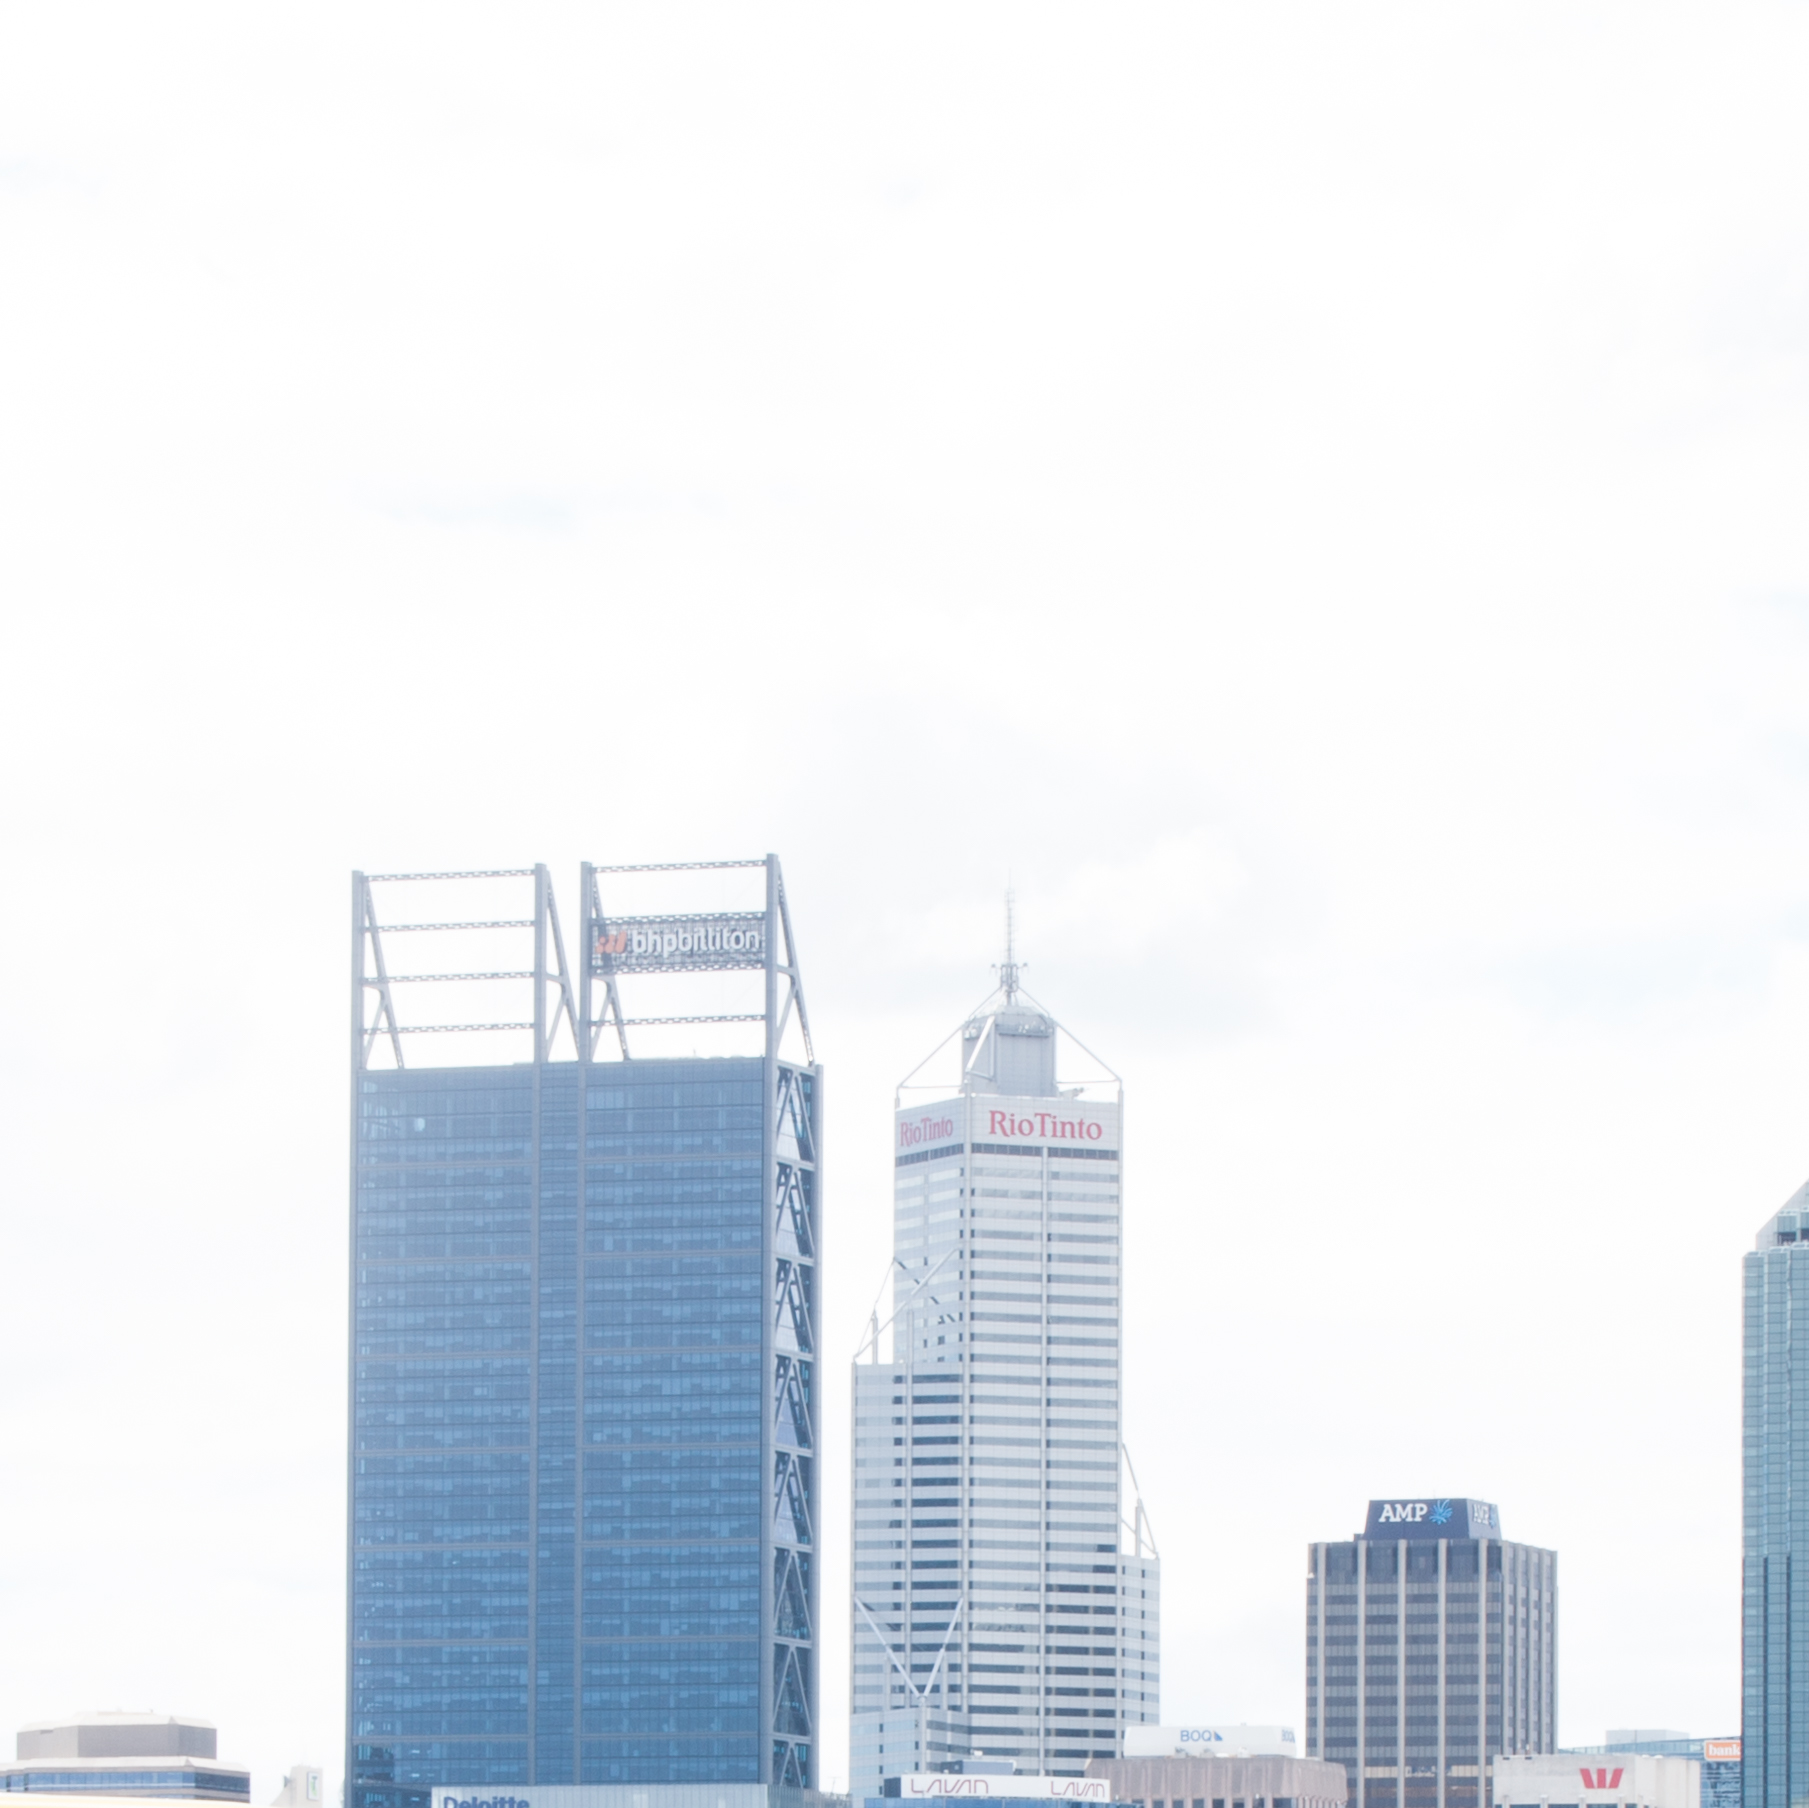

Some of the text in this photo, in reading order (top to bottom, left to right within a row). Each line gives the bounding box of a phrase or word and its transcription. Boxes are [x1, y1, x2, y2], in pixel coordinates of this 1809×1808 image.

[1378, 1503, 1428, 1522] AMP
[1180, 1730, 1213, 1742] BOQ
[911, 1778, 990, 1795] LAVAN
[1050, 1780, 1106, 1798] LAVAN
